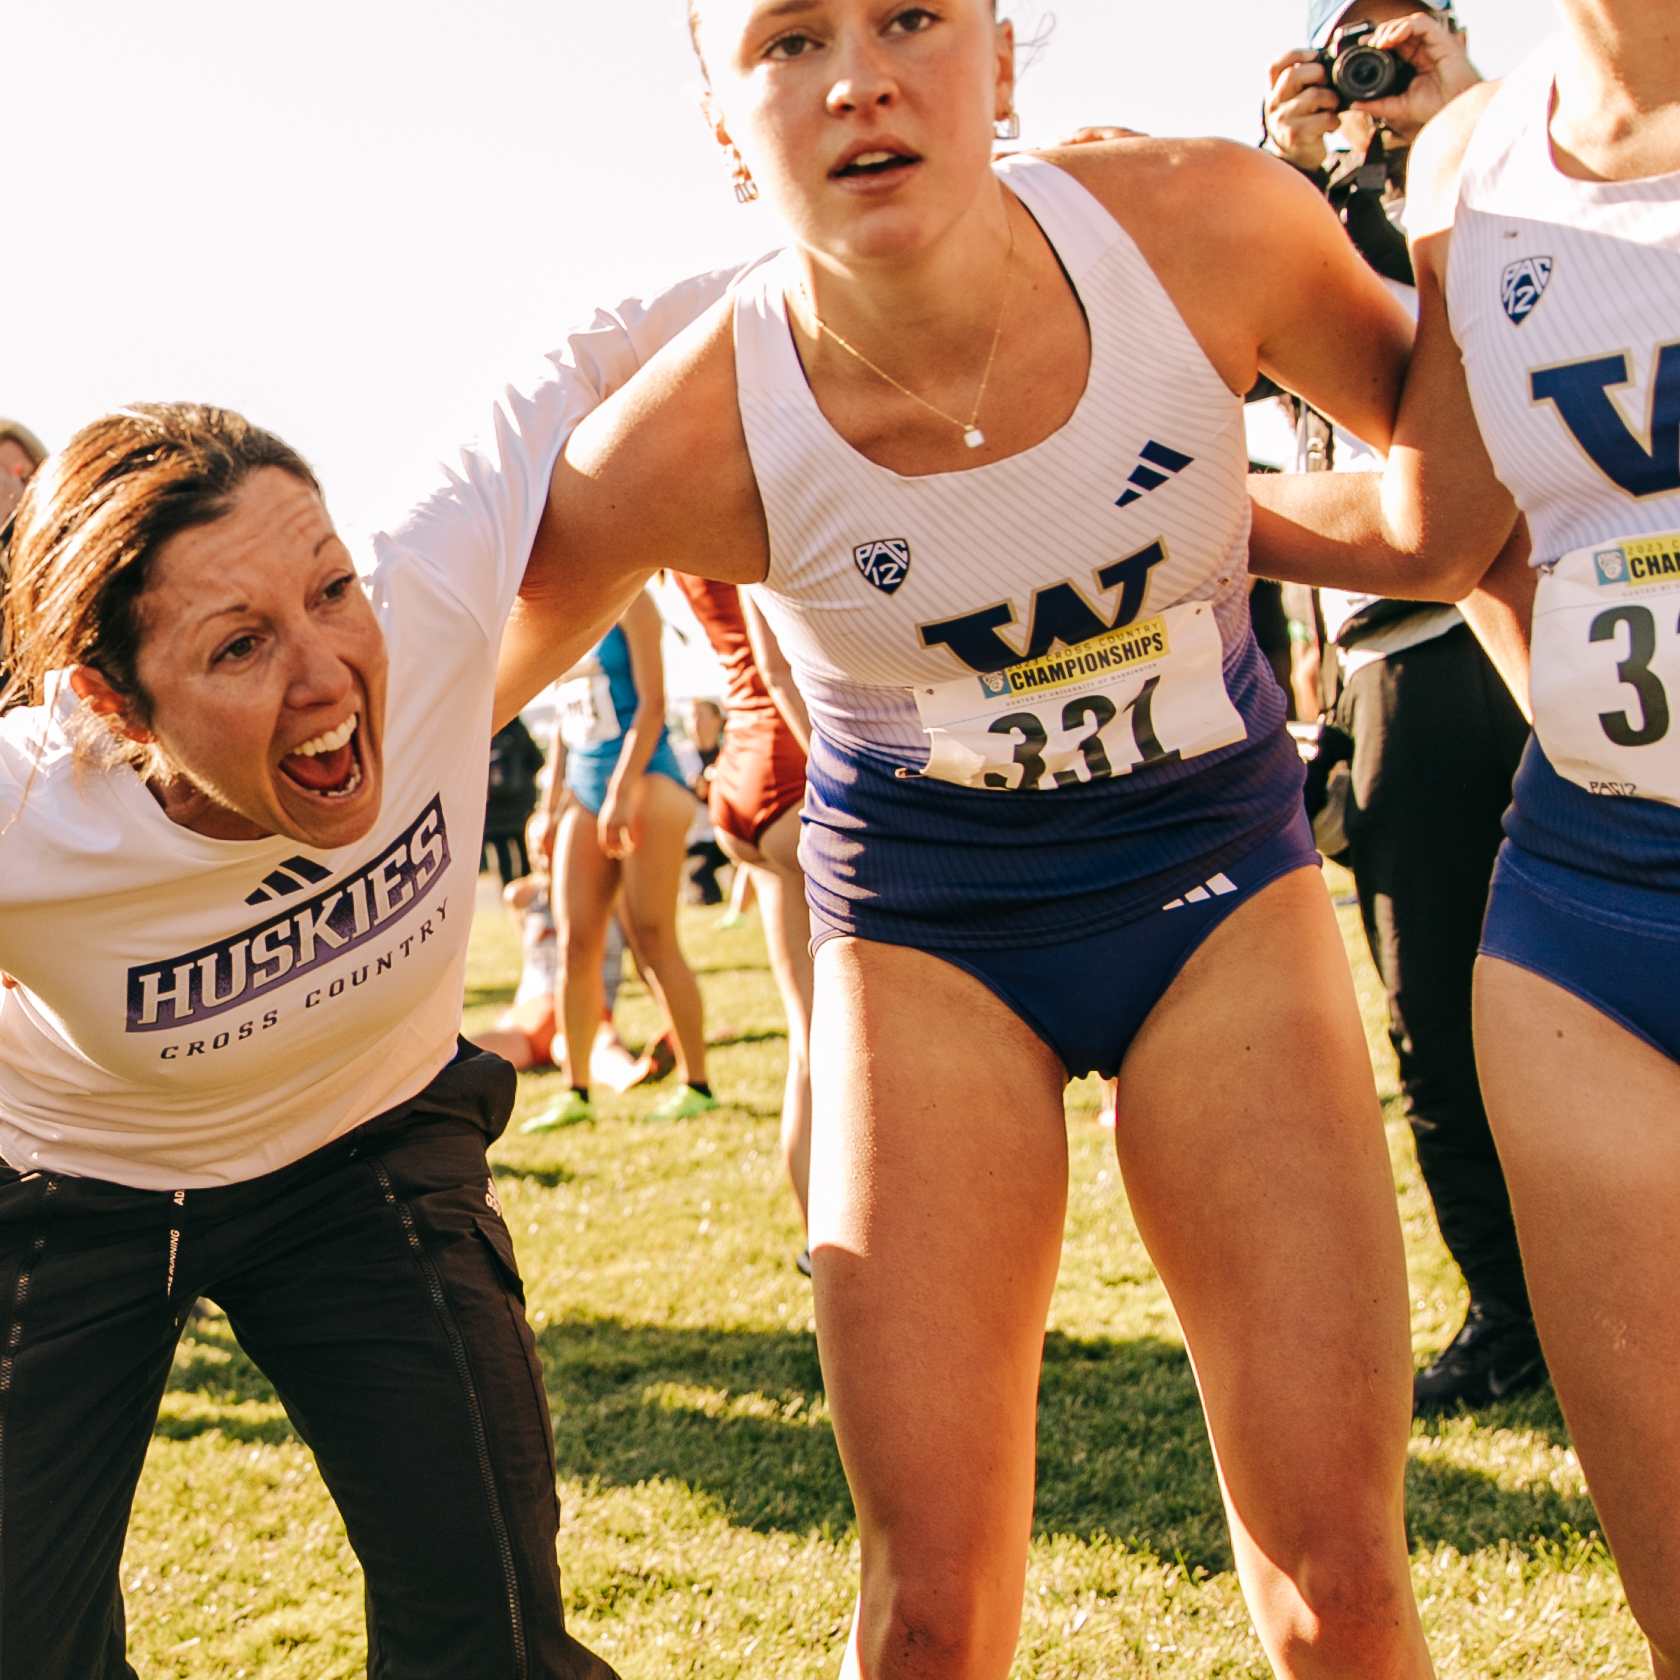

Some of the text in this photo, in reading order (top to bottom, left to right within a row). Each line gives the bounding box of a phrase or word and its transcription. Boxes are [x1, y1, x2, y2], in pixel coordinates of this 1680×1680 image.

[1503, 258, 1551, 302] PAC
[1507, 285, 1533, 315] 12
[855, 540, 908, 576] PAC
[872, 563, 902, 586] 12
[915, 534, 1170, 674] W
[1010, 632, 1163, 691] CHAMPIONSHIPS
[1046, 641, 1091, 662] CROSS
[1098, 622, 1158, 647] COUNTRY
[1589, 605, 1680, 747] 3
[136, 807, 445, 1026] HUSKIES
[160, 896, 451, 1061] CROSS COUNTRY
